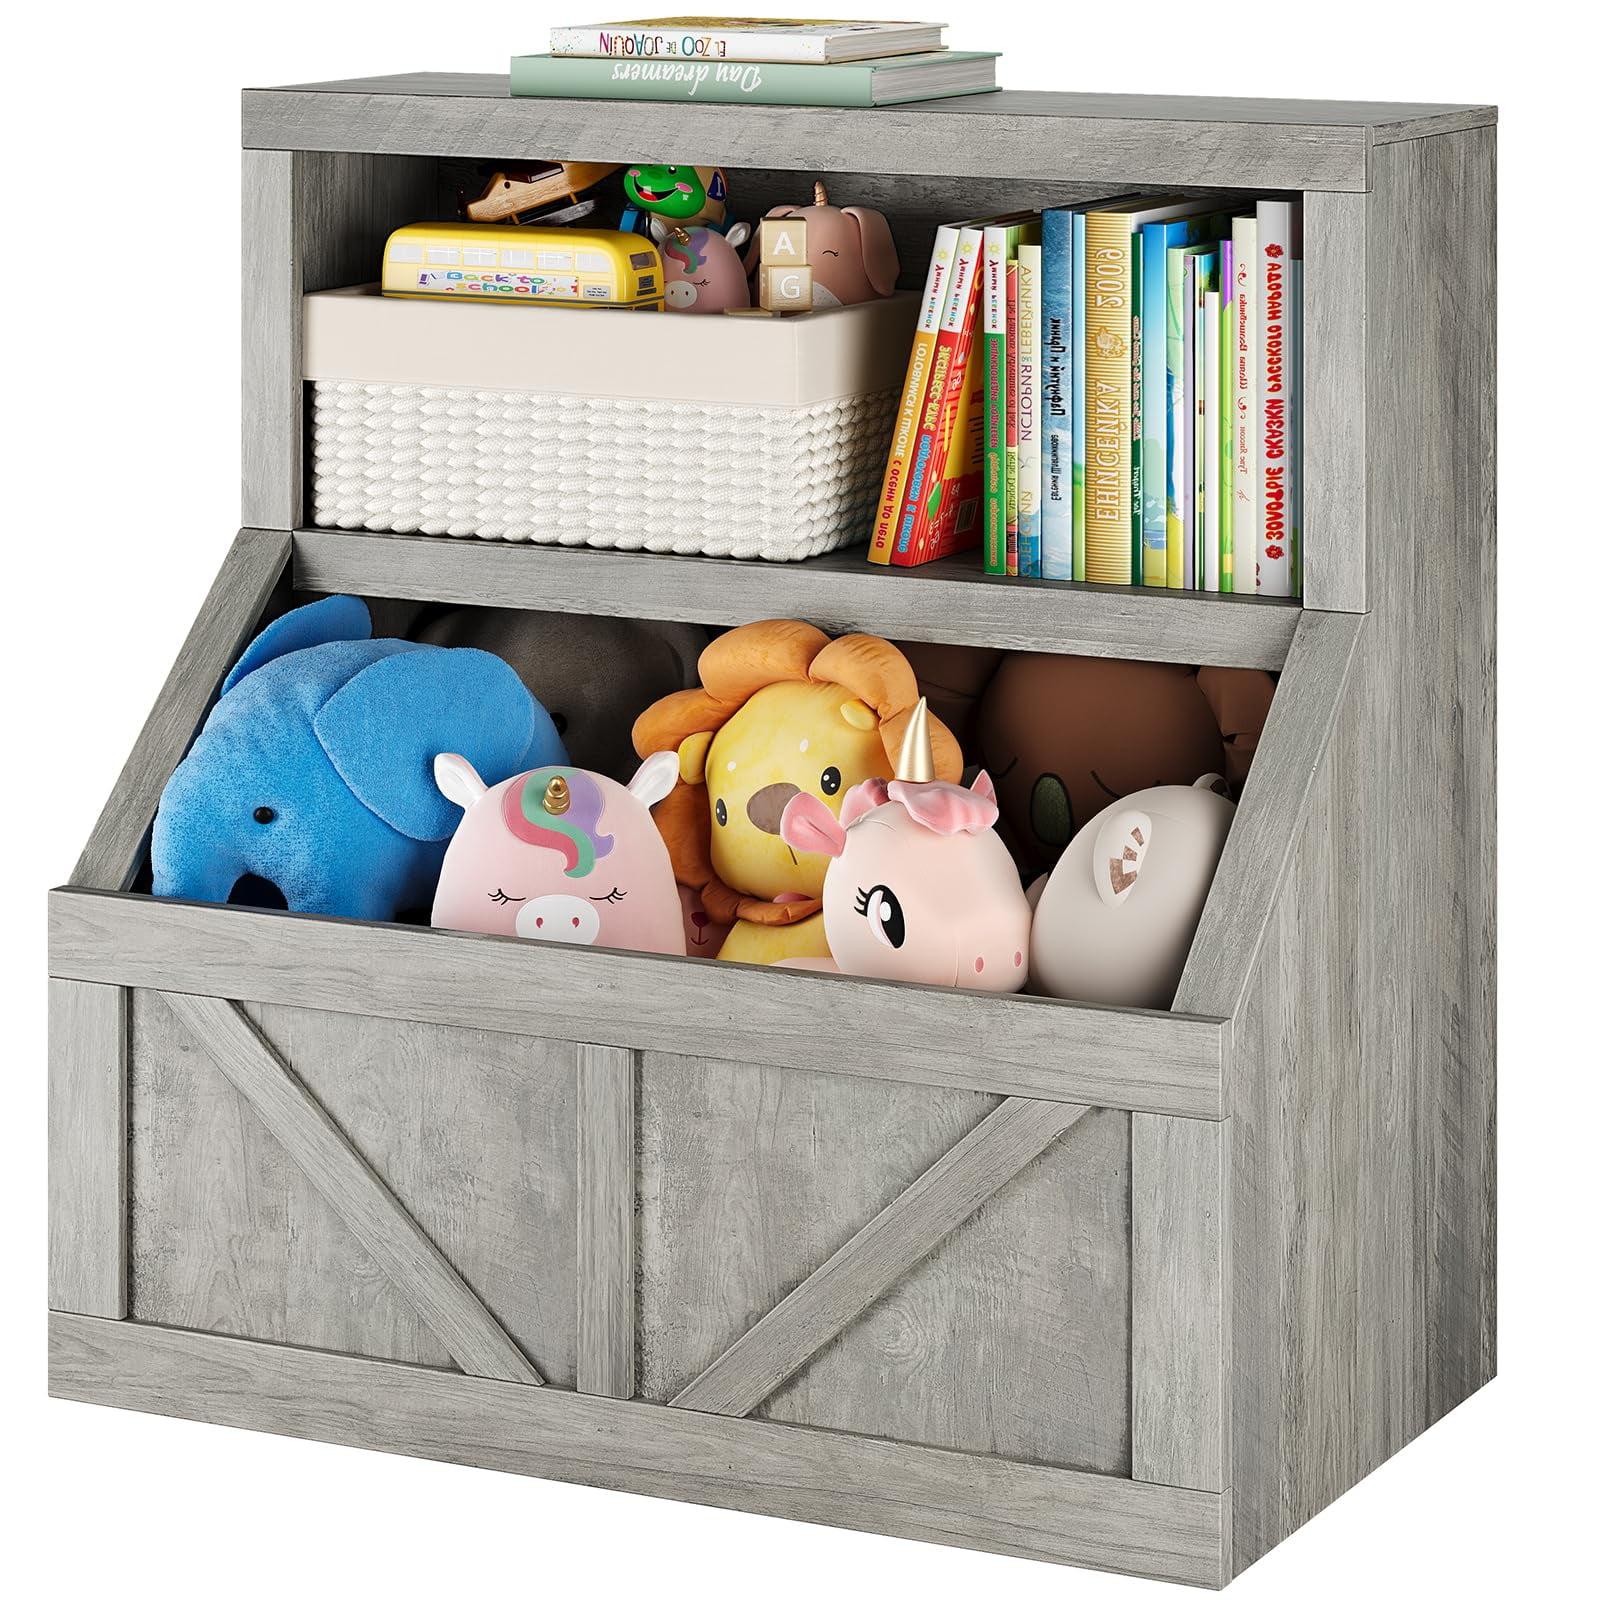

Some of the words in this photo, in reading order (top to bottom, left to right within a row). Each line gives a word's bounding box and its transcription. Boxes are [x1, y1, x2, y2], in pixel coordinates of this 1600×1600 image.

[600, 32, 664, 56] JOAQUÍN
[665, 42, 676, 54] DE
[681, 36, 711, 56] ZOO
[714, 40, 726, 57] EL
[611, 62, 711, 96] dreamers
[716, 62, 761, 93] Day
[772, 231, 796, 256] A
[447, 271, 509, 283] Back
[517, 276, 545, 285] to
[456, 282, 539, 294] school
[780, 275, 801, 299] G
